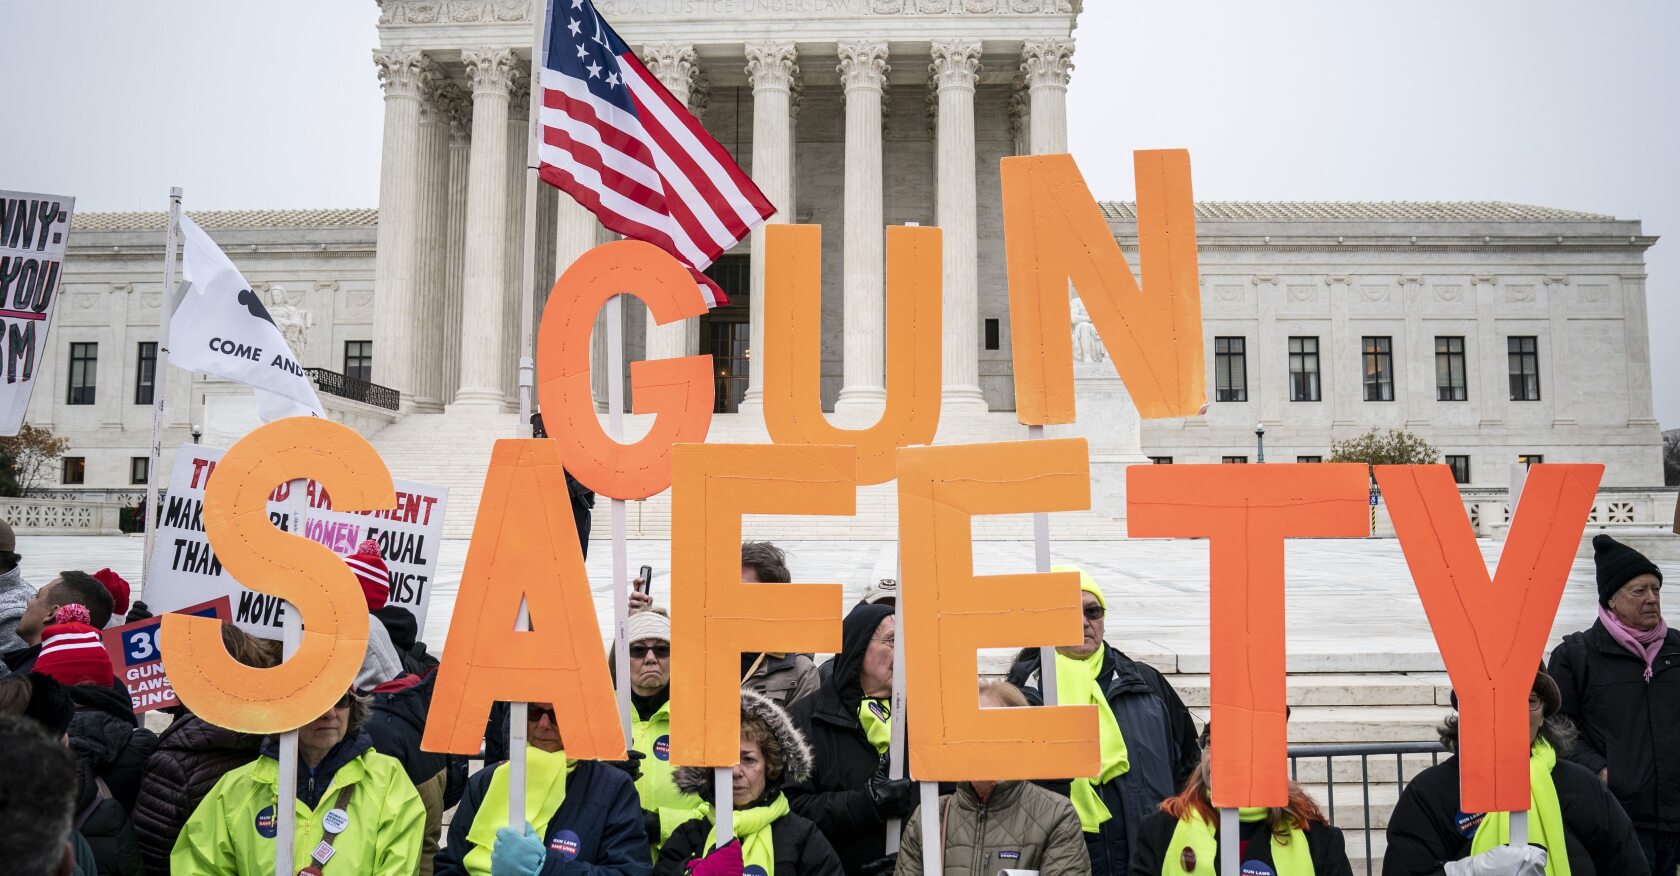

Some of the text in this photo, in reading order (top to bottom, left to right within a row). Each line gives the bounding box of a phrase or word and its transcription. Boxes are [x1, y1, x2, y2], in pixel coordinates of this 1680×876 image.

[659, 0, 733, 14] JUSTICE
[744, 0, 809, 12] UNDER
[814, 0, 851, 11] LAW
[0, 256, 60, 312] YOU
[537, 149, 1208, 501] GUN
[0, 319, 36, 384] M
[209, 337, 304, 378] COME AND
[164, 495, 206, 532] MAK
[172, 538, 222, 577] THAN
[161, 417, 1606, 814] SAFETY
[126, 663, 165, 681] GUN
[127, 676, 171, 695] LAWS
[132, 688, 176, 709] SINC
